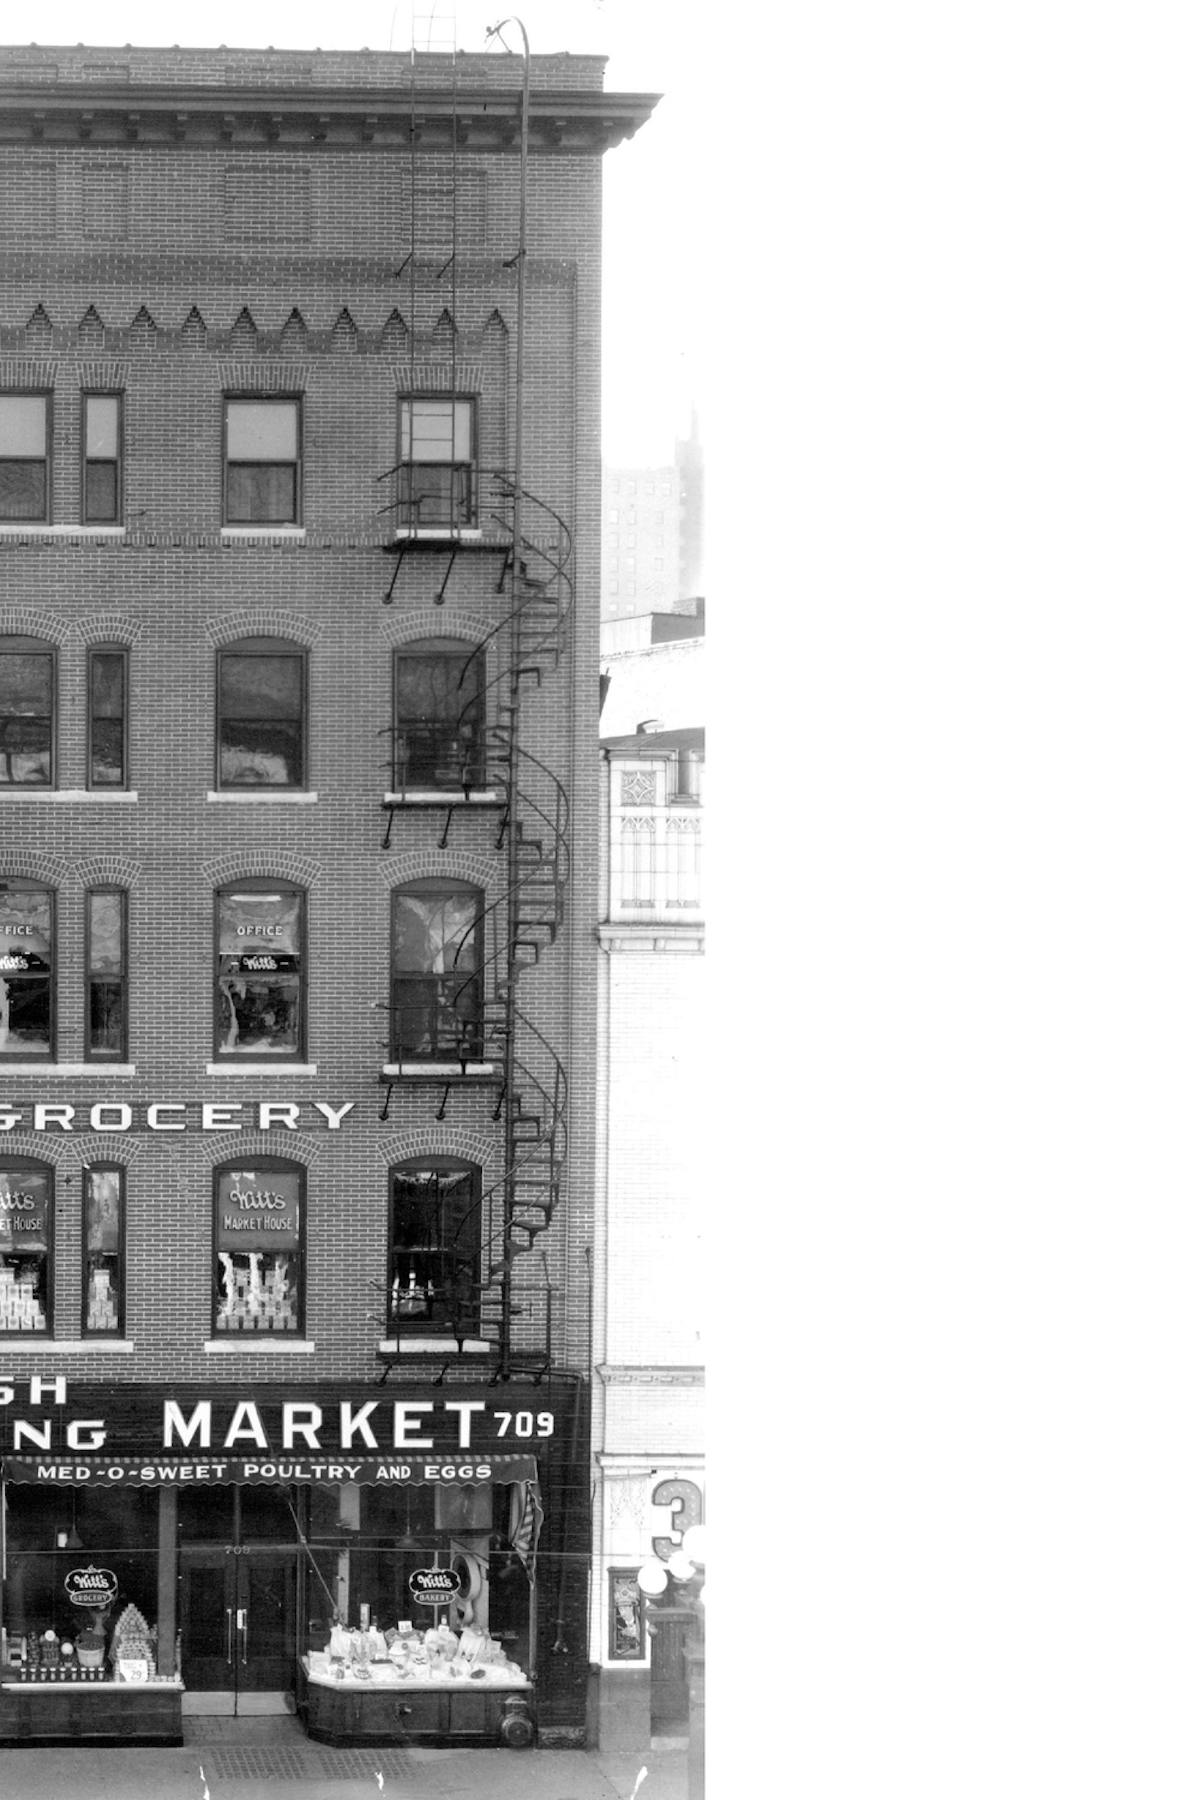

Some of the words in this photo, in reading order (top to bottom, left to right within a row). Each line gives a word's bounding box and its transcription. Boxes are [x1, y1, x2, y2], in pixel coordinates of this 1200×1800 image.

[236, 925, 283, 936] OFFICE
[163, 1400, 486, 1449] MARKET
[493, 1411, 555, 1438] 709
[244, 1464, 361, 1479] POULTRY
[376, 1465, 411, 1479] AND
[424, 1464, 492, 1479] EGGS
